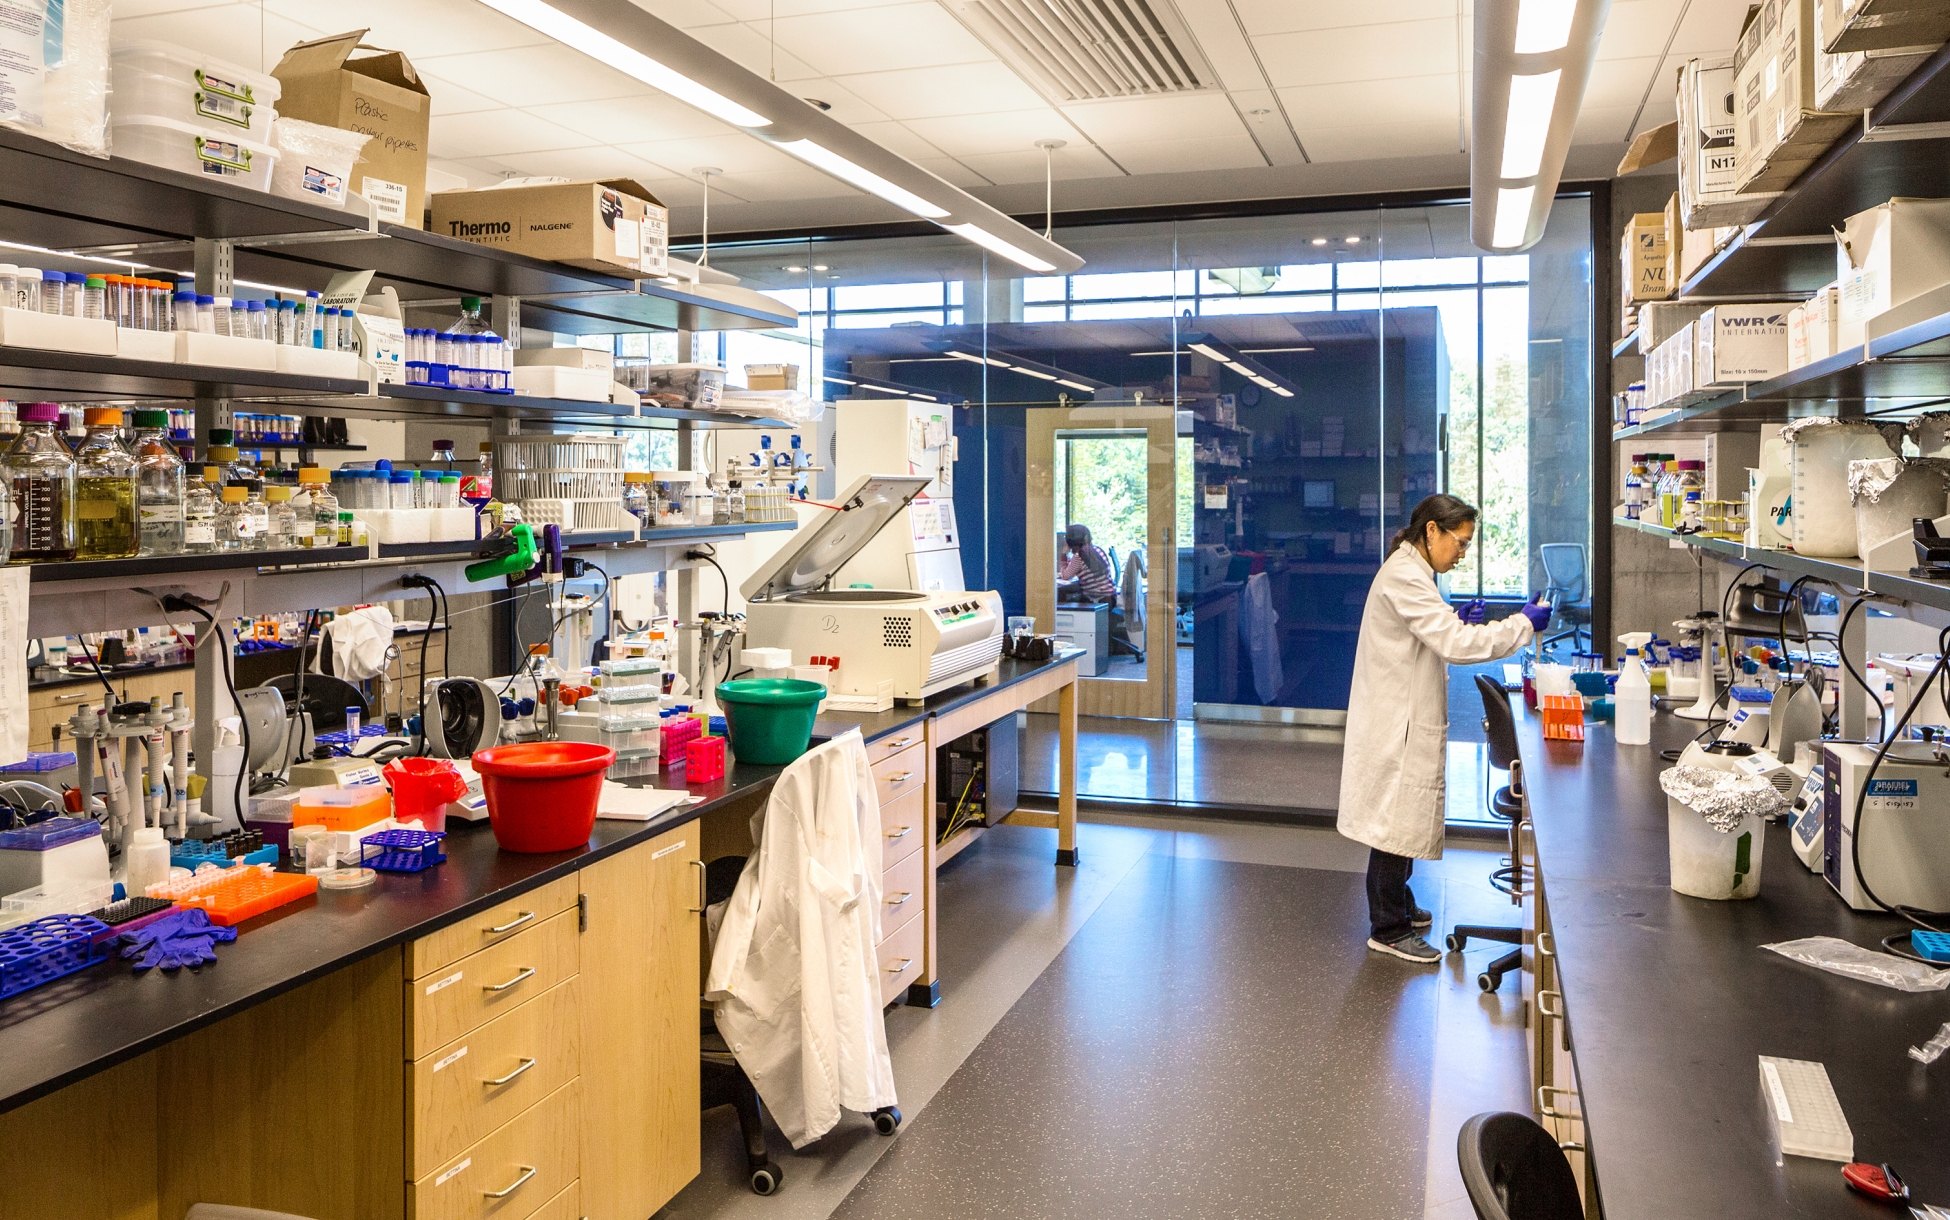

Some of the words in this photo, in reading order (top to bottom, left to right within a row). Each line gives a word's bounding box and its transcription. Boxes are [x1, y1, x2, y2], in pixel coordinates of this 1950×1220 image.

[355, 97, 388, 121] Plastic
[1716, 128, 1735, 136] NITR
[1711, 157, 1735, 169] N17
[449, 220, 511, 237] Thermo
[1642, 267, 1665, 281] NU
[1642, 283, 1665, 293] Bran
[323, 297, 358, 305] LABORATORY
[1721, 317, 1765, 328] VWR
[1722, 327, 1785, 336] INTERNATIO
[1770, 506, 1792, 517] PAR
